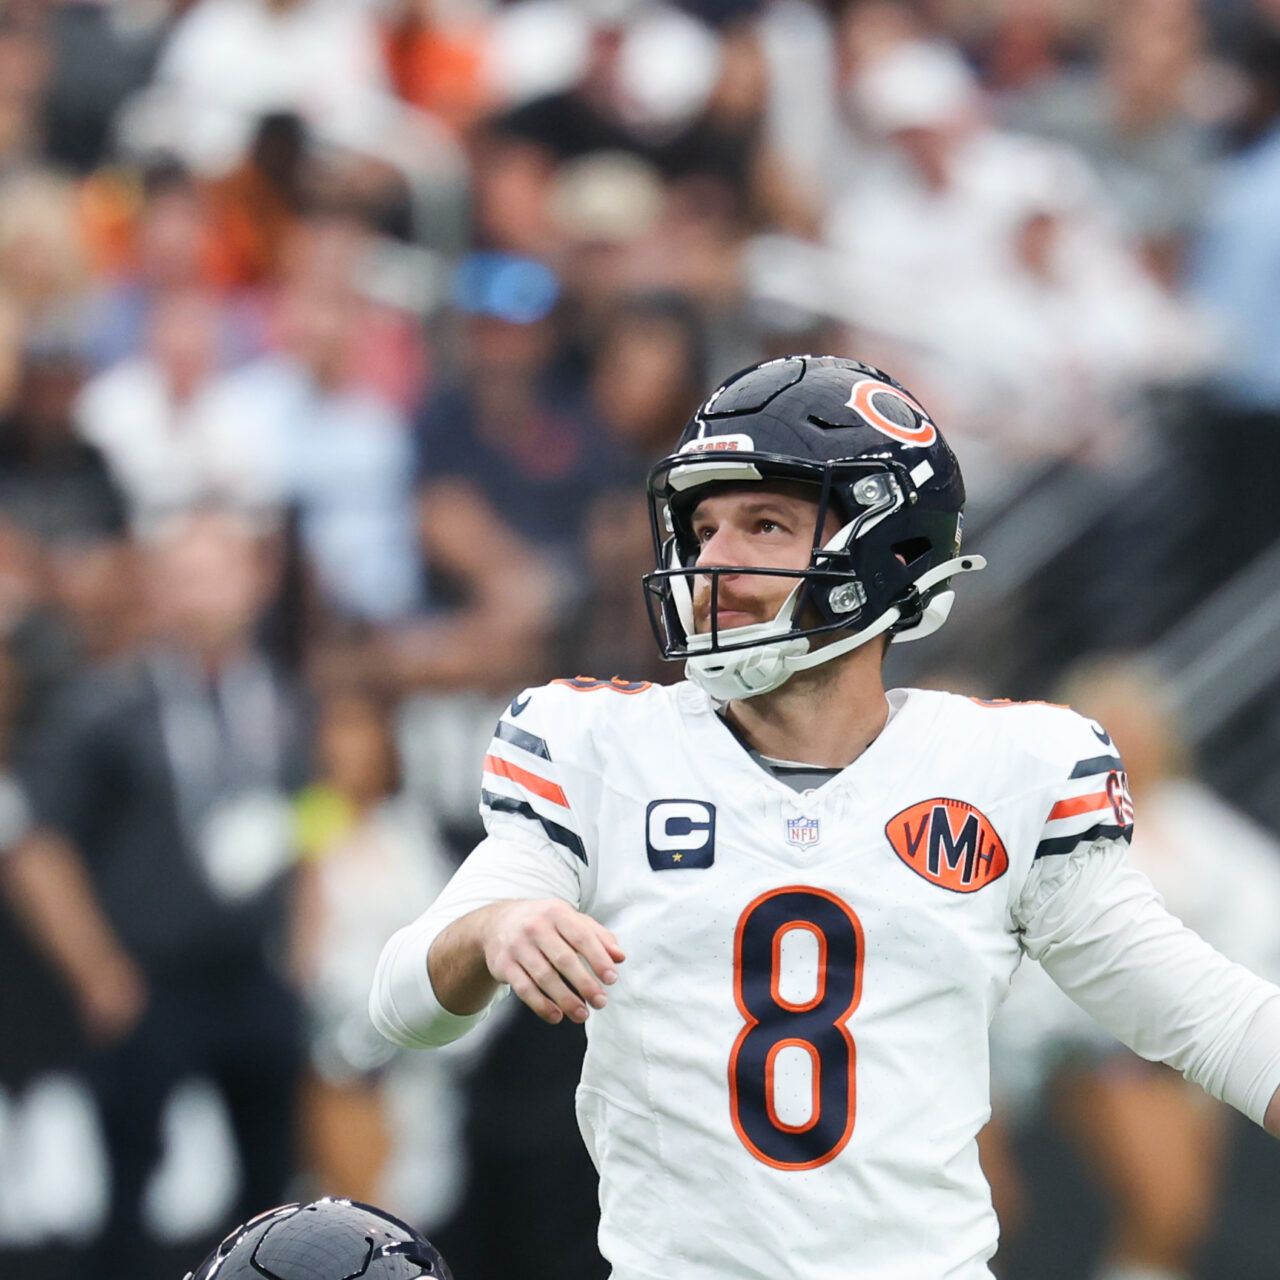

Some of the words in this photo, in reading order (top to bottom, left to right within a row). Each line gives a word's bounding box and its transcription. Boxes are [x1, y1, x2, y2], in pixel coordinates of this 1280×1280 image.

[845, 379, 937, 448] C
[649, 803, 710, 851] C
[791, 828, 816, 842] NFL
[727, 885, 865, 1172] 8
